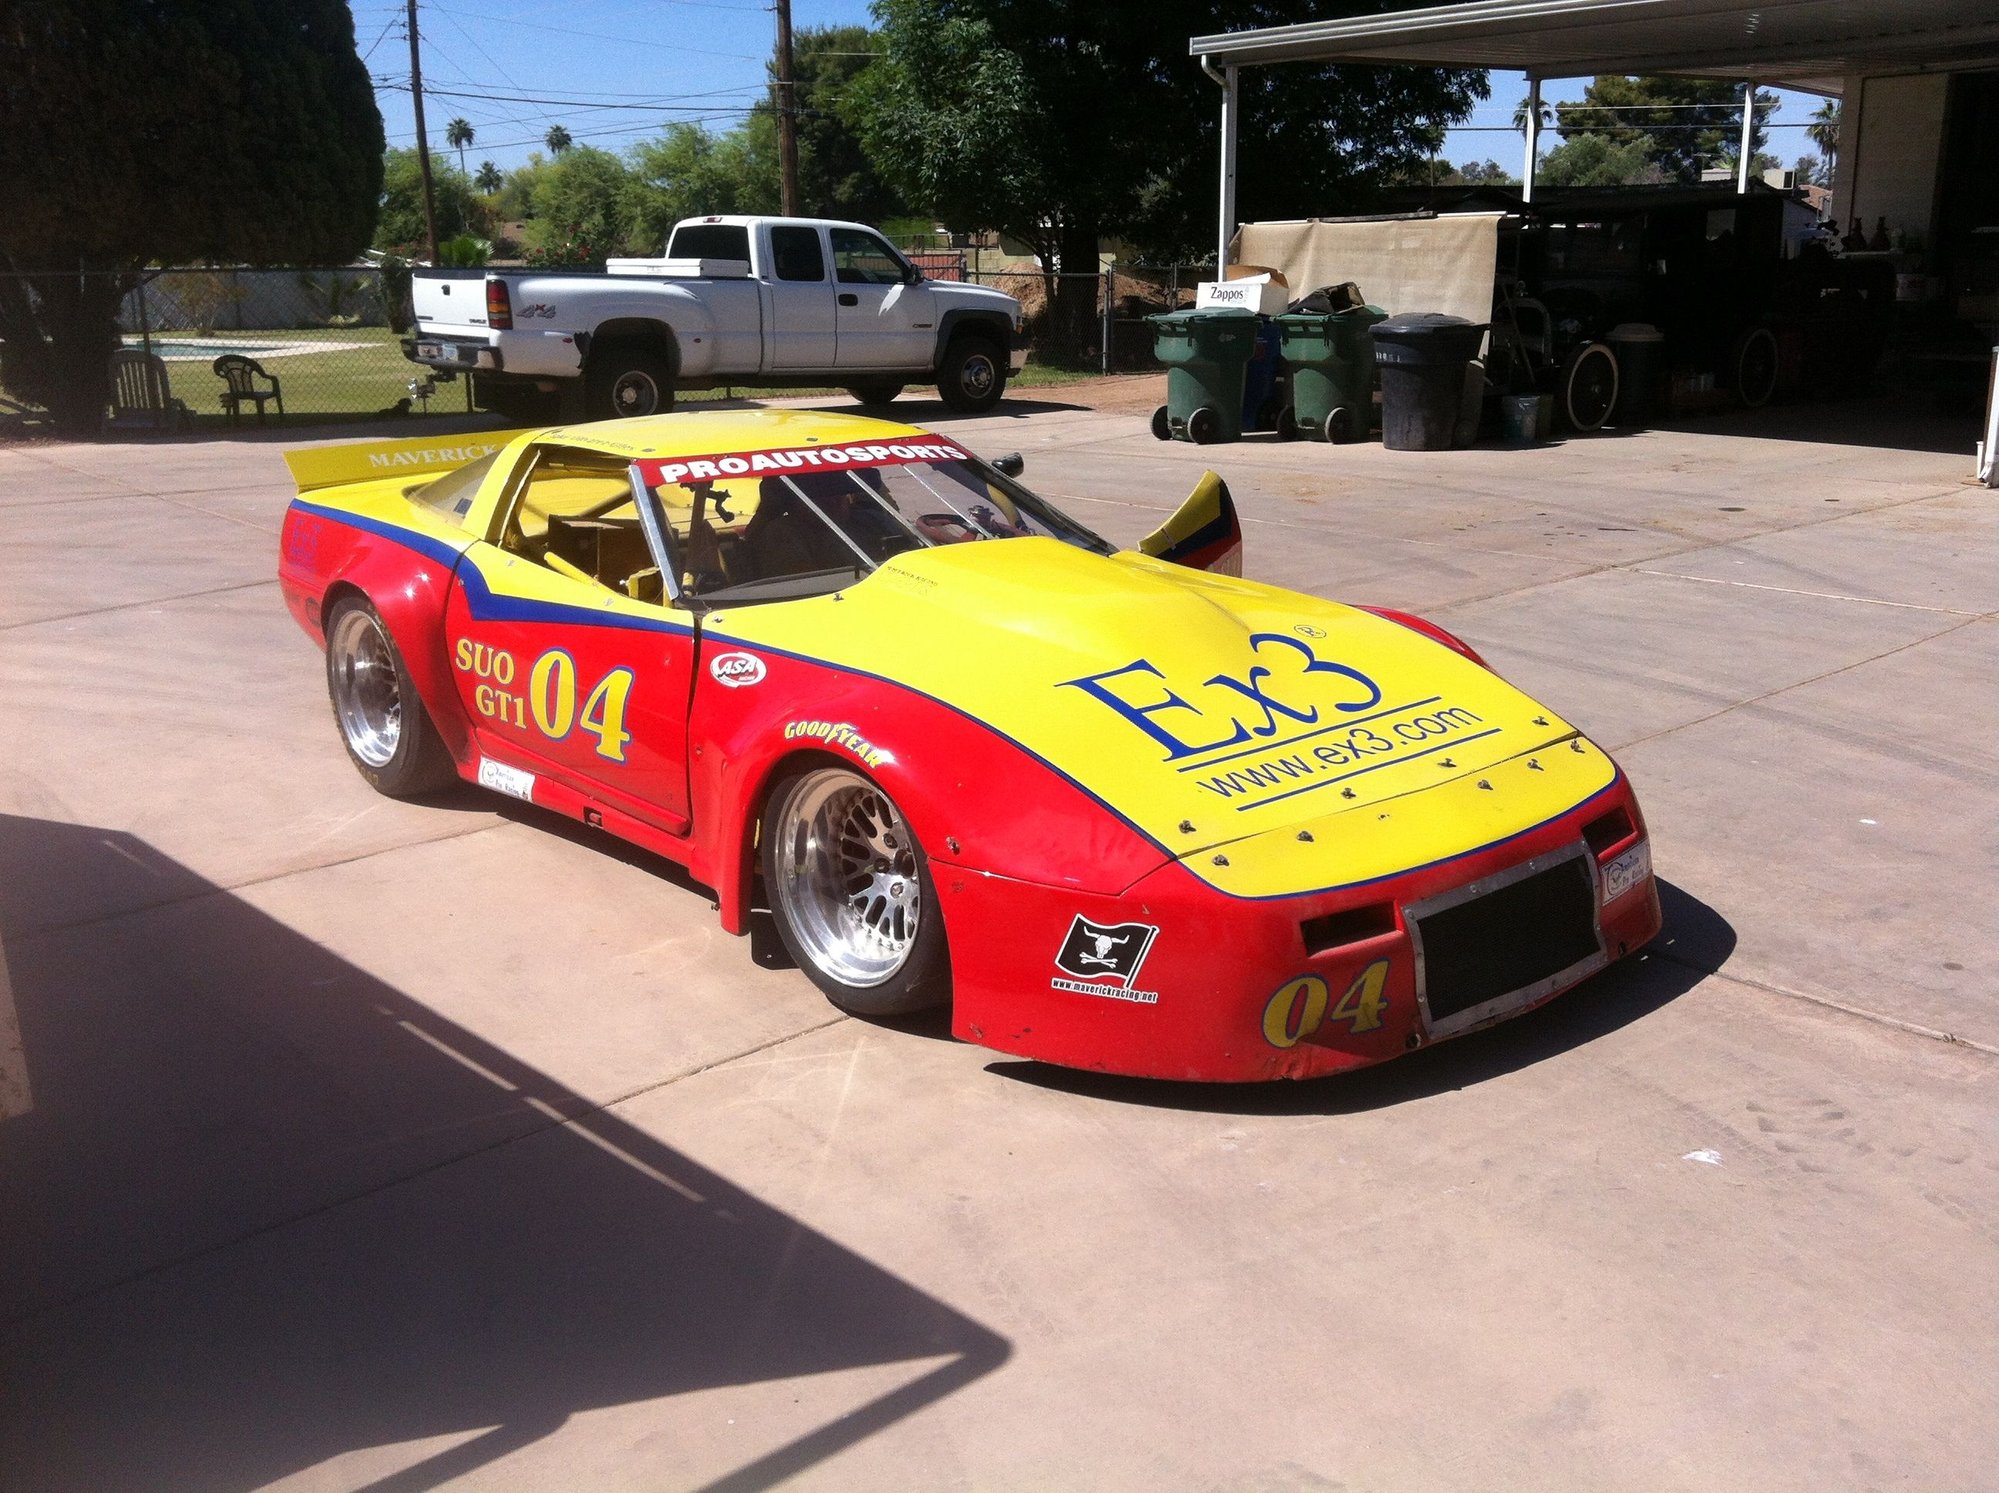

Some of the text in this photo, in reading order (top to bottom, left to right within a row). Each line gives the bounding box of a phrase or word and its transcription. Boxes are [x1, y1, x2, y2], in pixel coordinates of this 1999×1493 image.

[1210, 286, 1244, 302] Zappos
[368, 443, 498, 468] MAVERICK
[659, 444, 968, 484] PROAUTOSPORTS
[455, 638, 515, 685] SUO
[717, 659, 758, 678] ASA
[475, 684, 528, 730] GT1
[529, 647, 636, 765] 04
[1053, 632, 1382, 762] Ex3
[784, 720, 882, 769] GOODYEAR
[1195, 704, 1484, 799] www.ex3.com
[1052, 978, 1157, 1002] www.maverickracing.net
[1262, 957, 1390, 1051] 04
